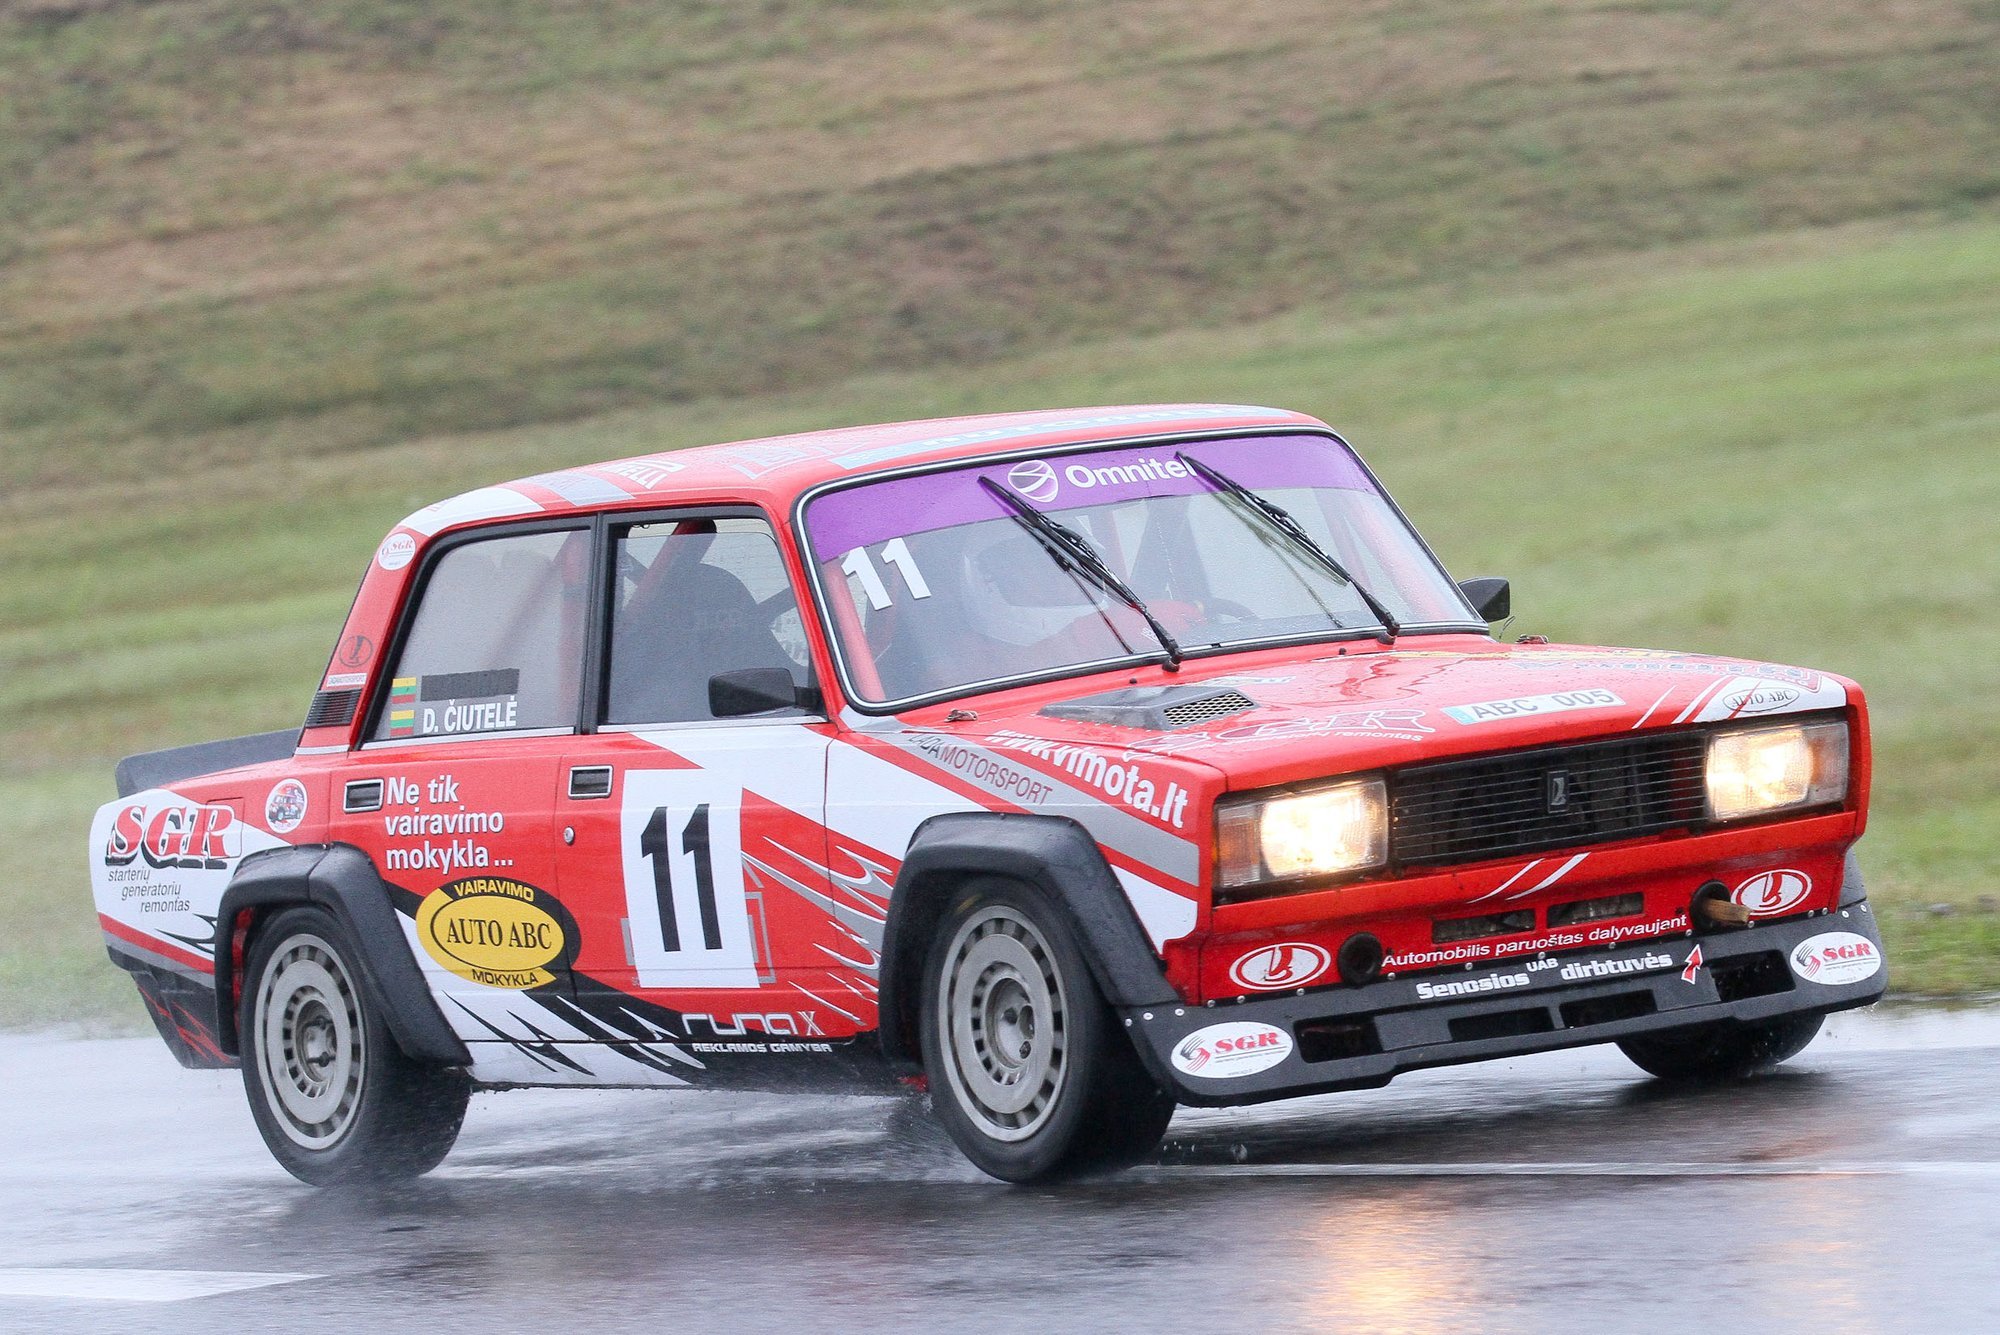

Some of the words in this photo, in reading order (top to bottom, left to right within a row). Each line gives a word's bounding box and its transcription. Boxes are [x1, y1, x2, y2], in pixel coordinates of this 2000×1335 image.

[1065, 457, 1198, 489] Omnitel
[841, 537, 931, 610] 11
[1473, 698, 1539, 720] ABC
[1550, 690, 1617, 710] 005
[1768, 689, 1793, 703] ABC
[422, 708, 439, 734] D.
[444, 695, 518, 732] ČIUTELĖ
[1333, 730, 1424, 742] remontas
[386, 776, 420, 805] Ne
[427, 774, 460, 804] tik
[384, 805, 505, 836] vairavimo
[105, 805, 231, 870] SGR
[453, 878, 535, 902] VAIRAVIMO
[641, 803, 723, 953] 11
[140, 897, 191, 913] remontas
[446, 917, 504, 948] AUTO
[508, 921, 553, 950] ABC
[1381, 943, 1491, 967] Automobilis
[1495, 931, 1584, 959] paruoštas
[1588, 914, 1688, 941] dalyvaujant
[1823, 943, 1872, 962] SGR
[471, 968, 540, 987] MOKYKLA
[1415, 972, 1531, 1000] Senosios
[1525, 957, 1560, 973] UAB
[1560, 952, 1674, 981] dirbtuvės
[691, 1042, 767, 1053] REKLAMOS
[770, 1042, 834, 1053] GAMYBA
[1214, 1031, 1281, 1055] SGR
